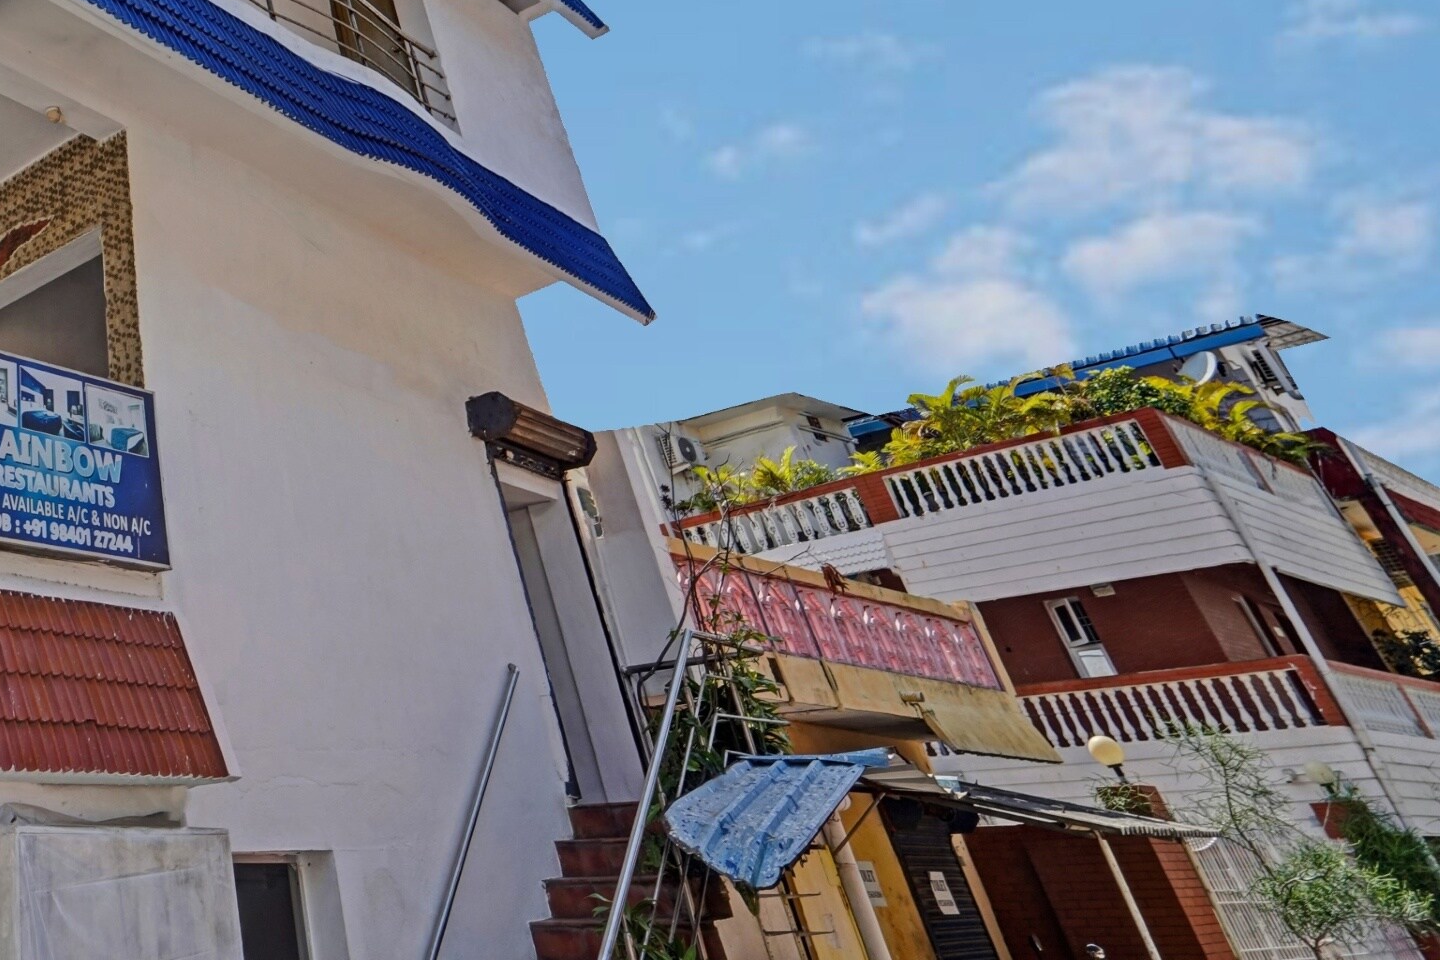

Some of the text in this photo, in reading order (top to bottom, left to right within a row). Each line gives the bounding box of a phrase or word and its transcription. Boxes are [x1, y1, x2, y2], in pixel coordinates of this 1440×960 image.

[1, 493, 64, 520] AVAILABLE
[67, 505, 89, 525] A/C
[91, 512, 100, 527] &
[103, 512, 128, 532] NON
[131, 517, 152, 536] A/C
[23, 518, 47, 539] +91
[49, 521, 91, 547] 98401
[93, 530, 134, 553] 27244
